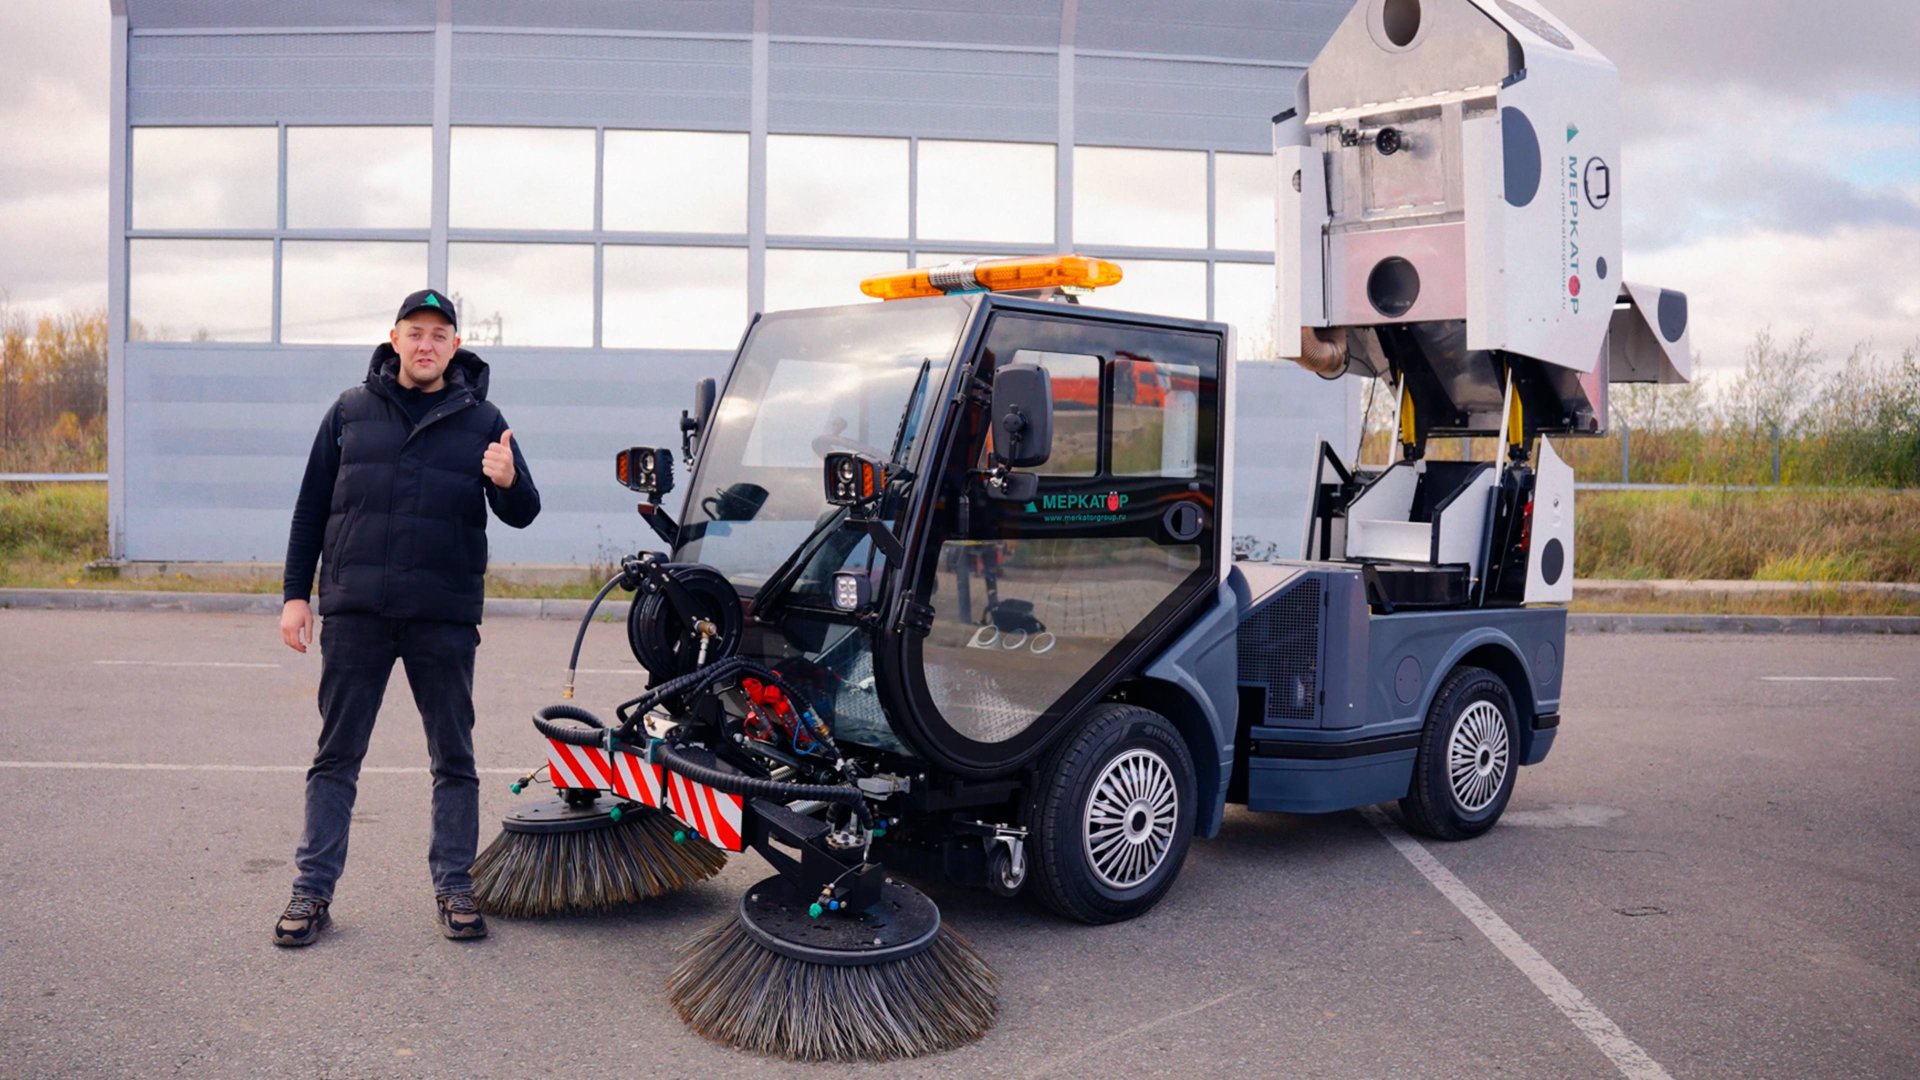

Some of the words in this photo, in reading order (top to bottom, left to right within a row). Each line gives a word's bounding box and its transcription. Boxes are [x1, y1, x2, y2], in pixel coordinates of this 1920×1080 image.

[1568, 156, 1581, 315] МЕРКАТОР
[1043, 493, 1129, 511] МЕРКАТОР
[1044, 514, 1127, 522] www.merkatorgroup.ru
